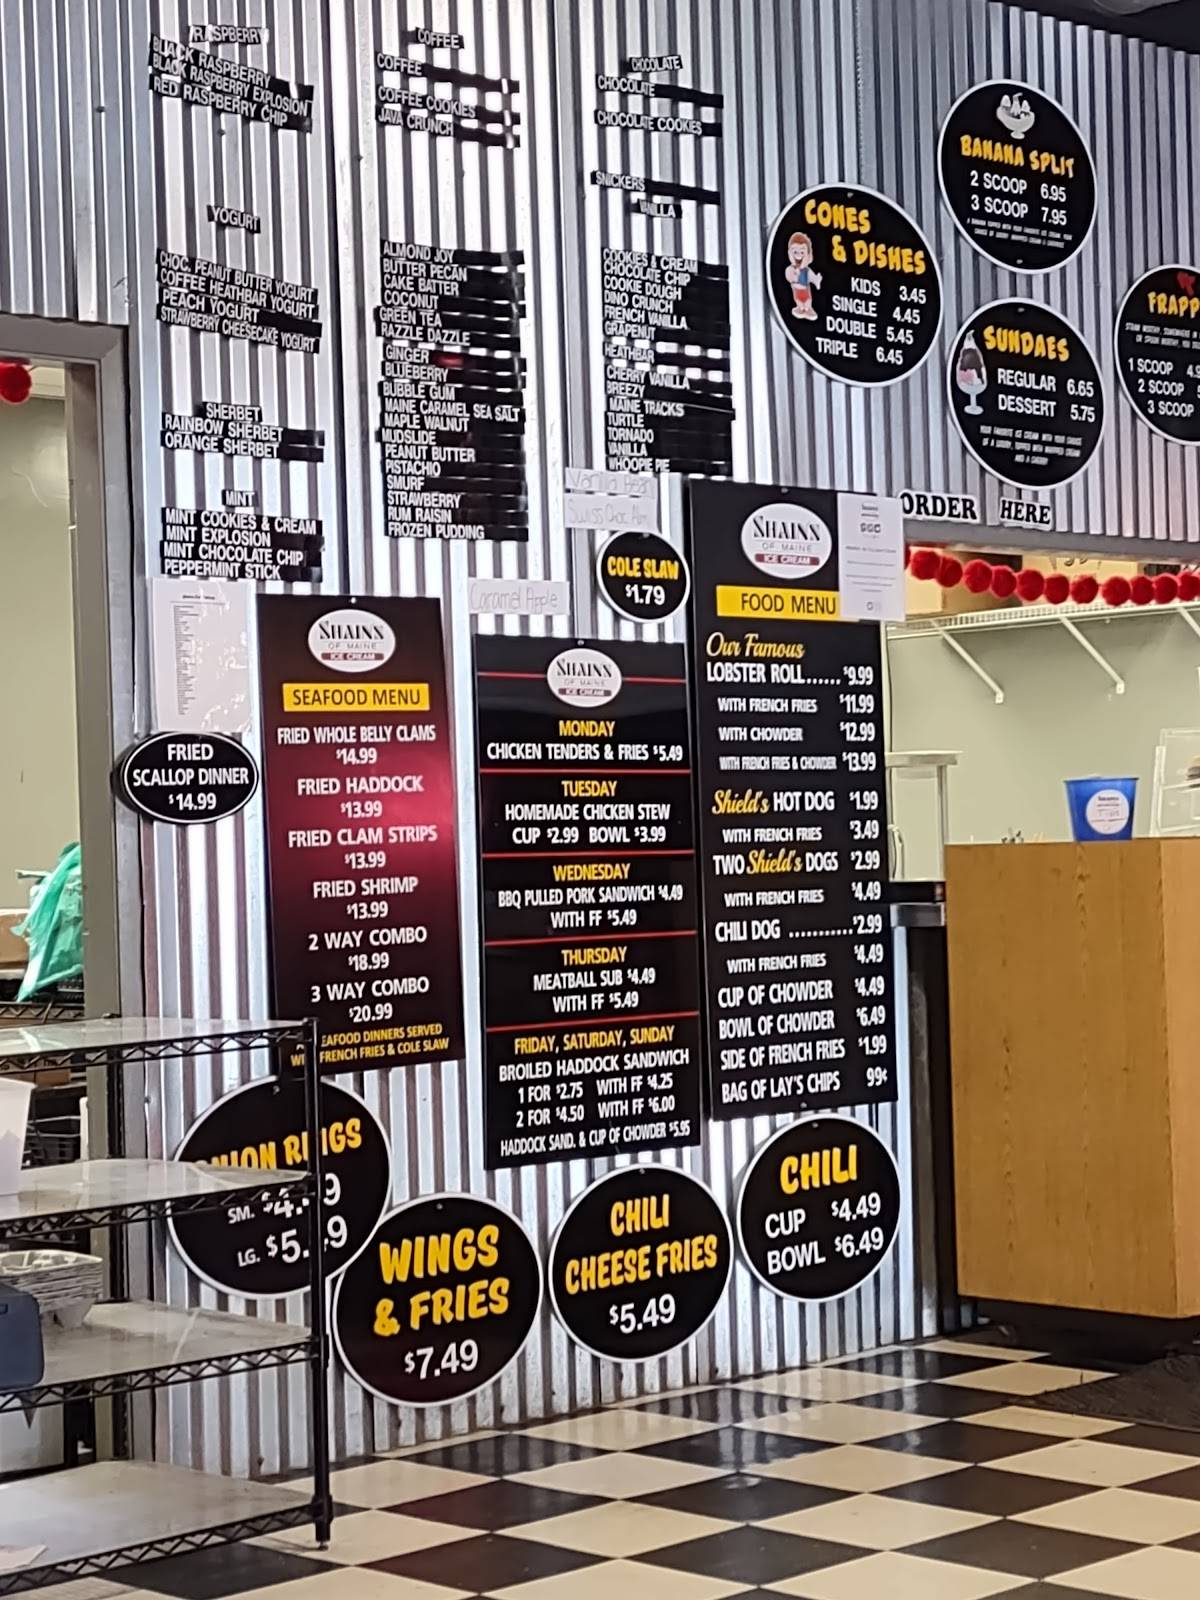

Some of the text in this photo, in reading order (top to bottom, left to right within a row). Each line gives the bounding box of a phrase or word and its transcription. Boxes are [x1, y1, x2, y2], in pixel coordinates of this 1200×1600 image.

[154, 77, 288, 126] RED RASPBERRY CHIP
[378, 86, 476, 118] COFFEE COOKIES
[597, 110, 702, 135] CHOCOLATE COOKIES
[961, 134, 1074, 178] BANANA SPLIT
[970, 170, 1066, 202] 2 SCOOP 6.95
[805, 199, 871, 234] CONES
[971, 195, 1067, 225] 3 SCOOP 7.95
[384, 241, 454, 263] ALMOND JOY
[832, 235, 926, 275] & DISHES
[383, 259, 467, 282] BUTTER PECAN
[852, 277, 926, 304] KIDS 3.45
[163, 289, 260, 322] PEACH YOGURT
[380, 307, 442, 327] GREEN TEA
[832, 295, 920, 324] SINGLE 4.45
[827, 316, 913, 344] DOUBLE 5.45
[816, 337, 903, 365] TRIPLE 6.45
[983, 325, 1070, 362] SUNDAES
[1128, 357, 1173, 375] 1 SCOOP
[998, 368, 1094, 397] REGULAR 6.65
[1138, 378, 1184, 396] 2 SCOOP
[607, 412, 644, 427] TURTLE
[998, 394, 1095, 422] DESSERT 5.75
[1148, 400, 1194, 417] 3 SCOOP
[165, 415, 283, 441] RAINBOW SHERBET
[385, 413, 469, 432] MAPLE WALNUT
[608, 427, 653, 443] TORNADO
[386, 460, 440, 476] PISTACHIO
[900, 493, 977, 520] ORDER
[1001, 499, 1050, 524] HERE
[388, 522, 484, 539] FROZEN PUDDING
[607, 556, 678, 580] COLE SLAW
[625, 584, 665, 605] $1.79
[741, 592, 836, 614] FOOD MENU
[707, 632, 805, 659] Our Famous
[293, 689, 421, 706] SEAFOOD MENU
[718, 694, 874, 713] WITH FRENCH FRIES $11.99
[278, 725, 436, 745] FRIED WHOLE BELLY CLAMS
[559, 720, 615, 737] MONDAY
[168, 744, 214, 761] FRIED
[337, 748, 377, 764] $14.99
[487, 743, 683, 762] CHICKEN TENDERS & FRIES $5.49
[133, 768, 249, 786] SCALLOP DINNER
[298, 776, 424, 796] FRIED HADDOCK
[562, 781, 617, 797] TUESDAY
[169, 792, 216, 810] $14.99
[341, 802, 383, 818] $13.99
[505, 804, 671, 821] HOMEMADE CHICKEN STEW
[712, 789, 878, 814] Shield's HOT DOG $1.99
[288, 825, 438, 848] FRIED CLAM STRIPS
[512, 826, 666, 844] CUP $2.99 BOWL $3.99
[345, 851, 386, 869] $13.99
[553, 863, 631, 882] WEDNESDAY
[313, 877, 418, 898] FRIED SHRIMP
[499, 884, 683, 909] BBQ PULLED PORK SANDWICH $4.49
[347, 901, 389, 920] $13.99
[551, 909, 637, 928] WITH FF $5.49
[308, 926, 427, 951] 2 WAY COMBO
[349, 952, 389, 971] $18.99
[311, 977, 429, 1003] 3 WAY COMBO
[718, 976, 885, 1008] CUP OF CHOWDER $4.49
[349, 1003, 393, 1022] $20.99
[722, 1082, 747, 1103] BAG
[751, 1079, 766, 1099] OF
[770, 1076, 803, 1097] LAY'S
[807, 1071, 840, 1092] CHIPS
[780, 1144, 857, 1194] CHILI
[228, 1205, 255, 1224] SM.
[611, 1193, 670, 1236] CHILI
[765, 1192, 881, 1238] CUP $4.49
[238, 1248, 260, 1267] LG.
[379, 1224, 499, 1284] WINGS
[767, 1227, 884, 1275] BOWL $6.49
[565, 1234, 718, 1295] CHEESE FRIES
[374, 1277, 509, 1336] & FRIES
[609, 1294, 676, 1334] $5.49
[404, 1339, 479, 1380] $7.49
